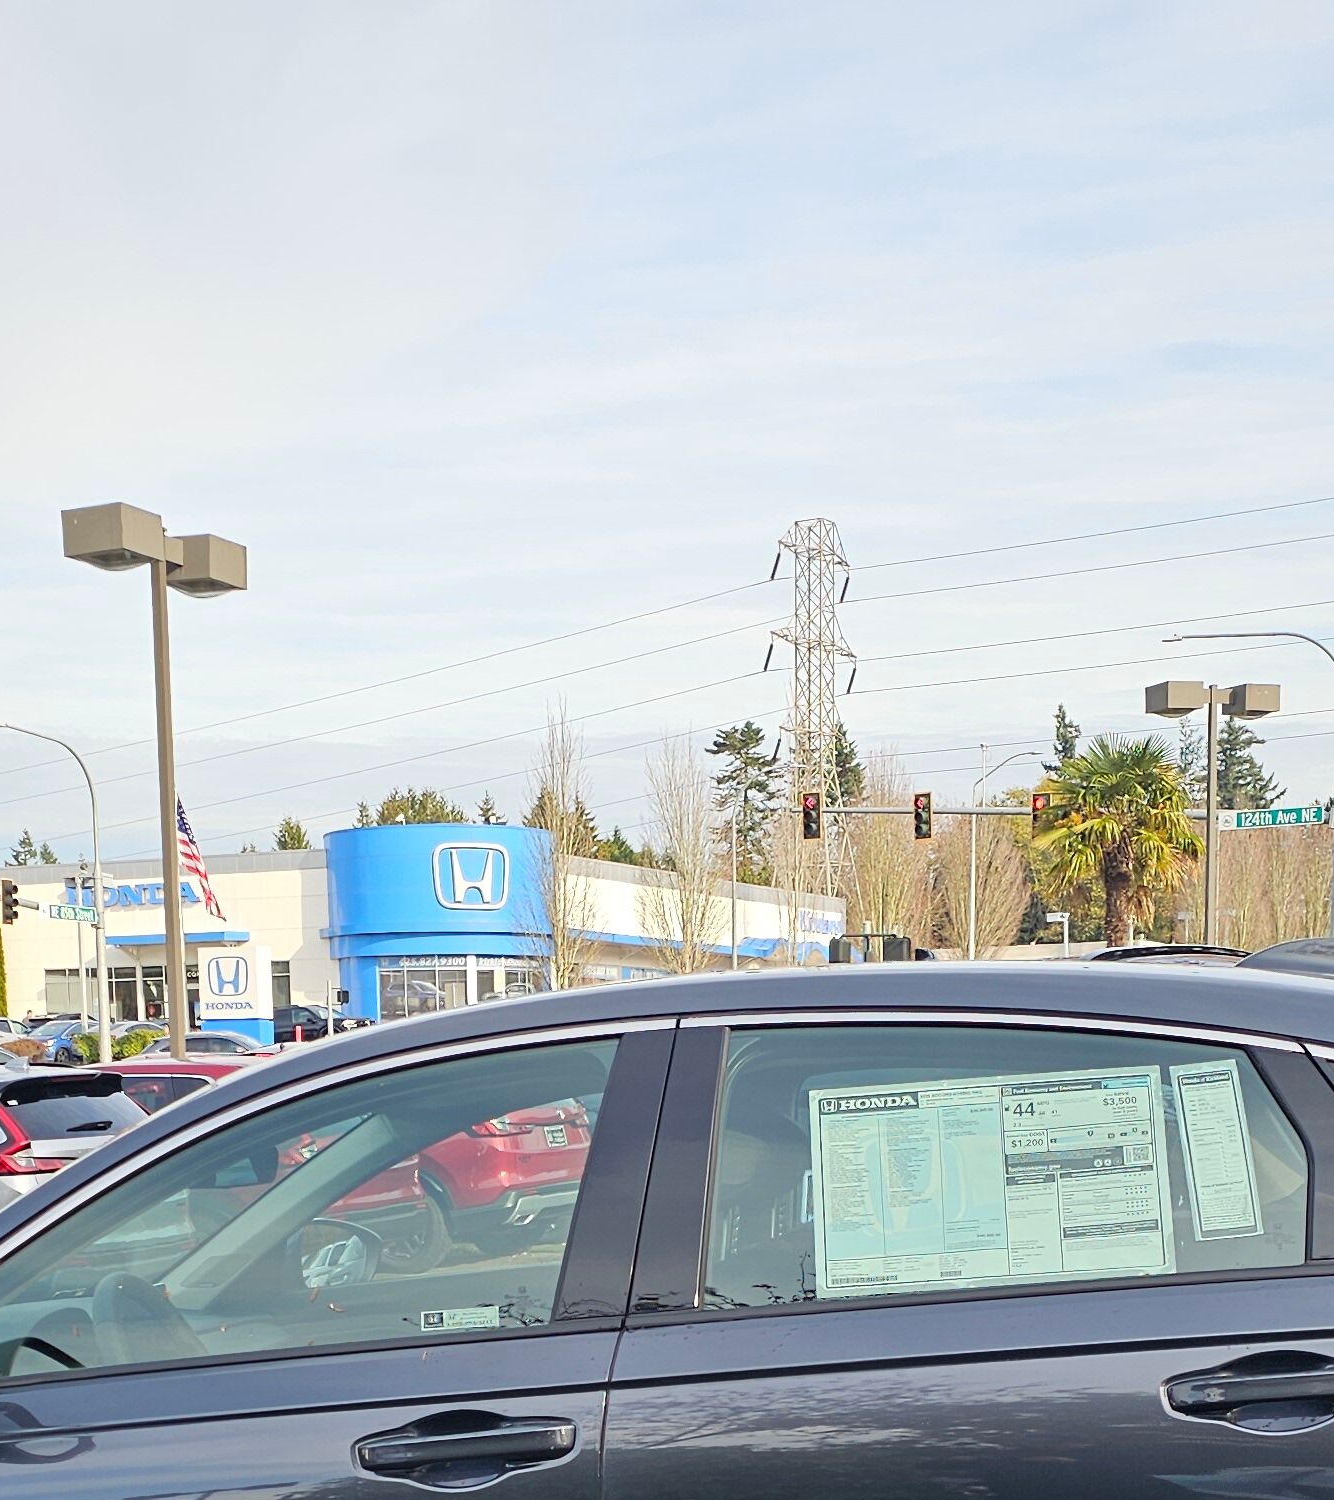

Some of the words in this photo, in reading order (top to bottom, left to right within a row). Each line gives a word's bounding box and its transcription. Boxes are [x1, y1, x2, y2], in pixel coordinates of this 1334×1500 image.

[1240, 811, 1273, 827] 124th
[1275, 810, 1298, 824] Ave
[1301, 808, 1318, 822] NE
[205, 1002, 254, 1010] HONDA
[839, 1095, 917, 1111] HONDA
[1102, 1096, 1137, 1106] $3,500
[1013, 1102, 1035, 1117] 44
[1011, 1138, 1044, 1149] $1,200
